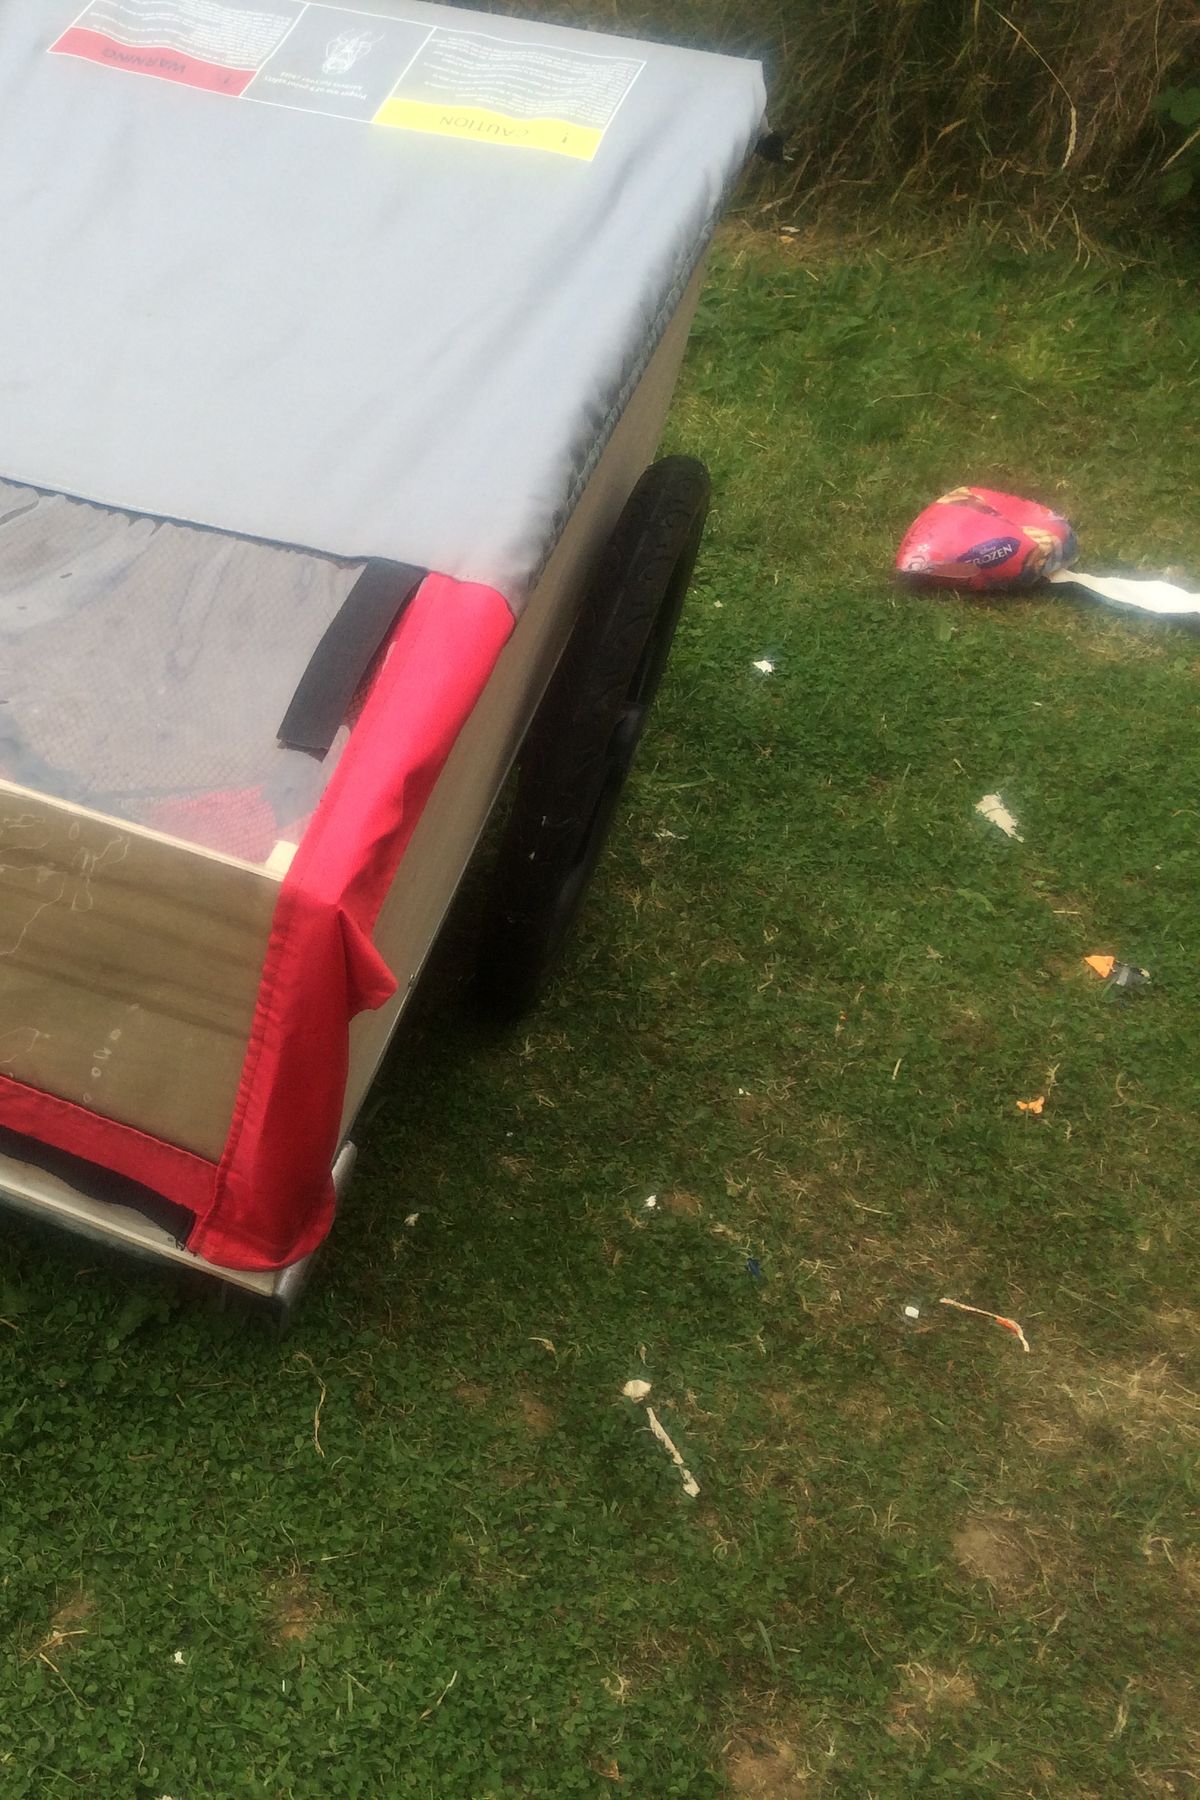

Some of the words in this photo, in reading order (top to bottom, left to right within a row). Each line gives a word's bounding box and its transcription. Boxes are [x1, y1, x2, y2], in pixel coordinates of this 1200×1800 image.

[102, 48, 186, 75] WARNING
[440, 115, 529, 139] CAUTION
[965, 544, 1012, 565] ROZEN
